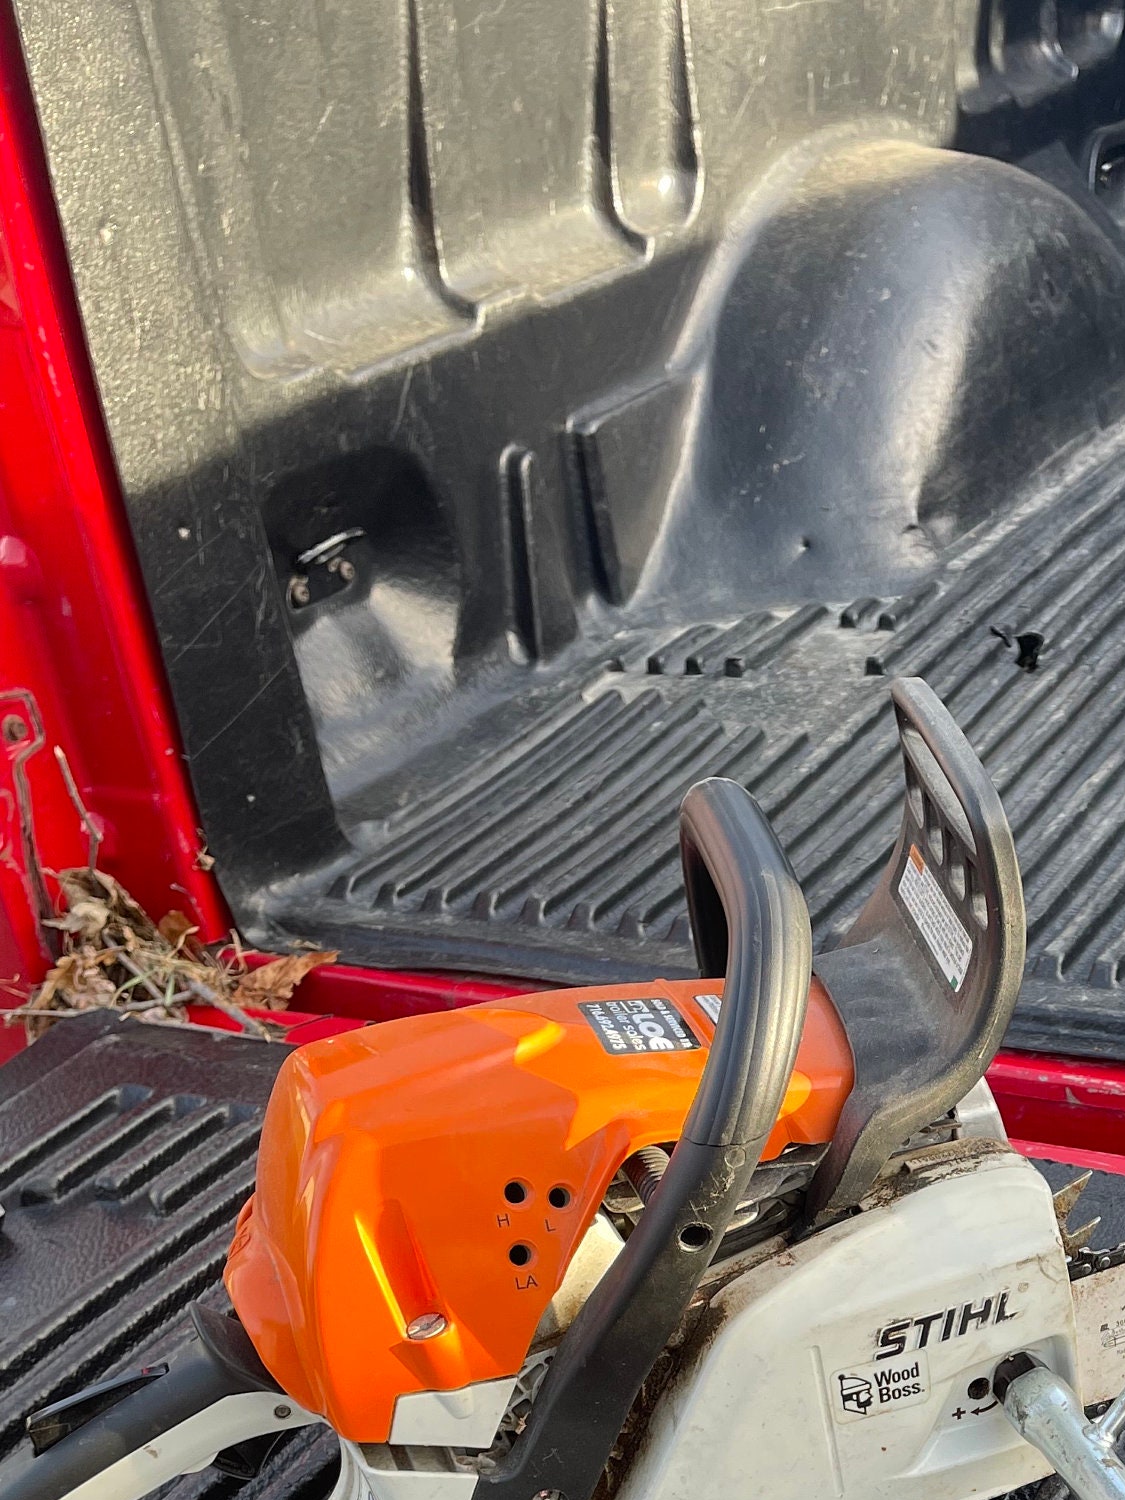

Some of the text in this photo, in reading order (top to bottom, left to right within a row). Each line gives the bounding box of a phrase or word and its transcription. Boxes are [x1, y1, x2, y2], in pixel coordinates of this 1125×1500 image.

[623, 1024, 647, 1050] sales
[496, 1213, 556, 1232] H L
[515, 1275, 538, 1290] LA
[873, 1289, 1021, 1361] STIHL
[874, 1362, 920, 1388] Wood
